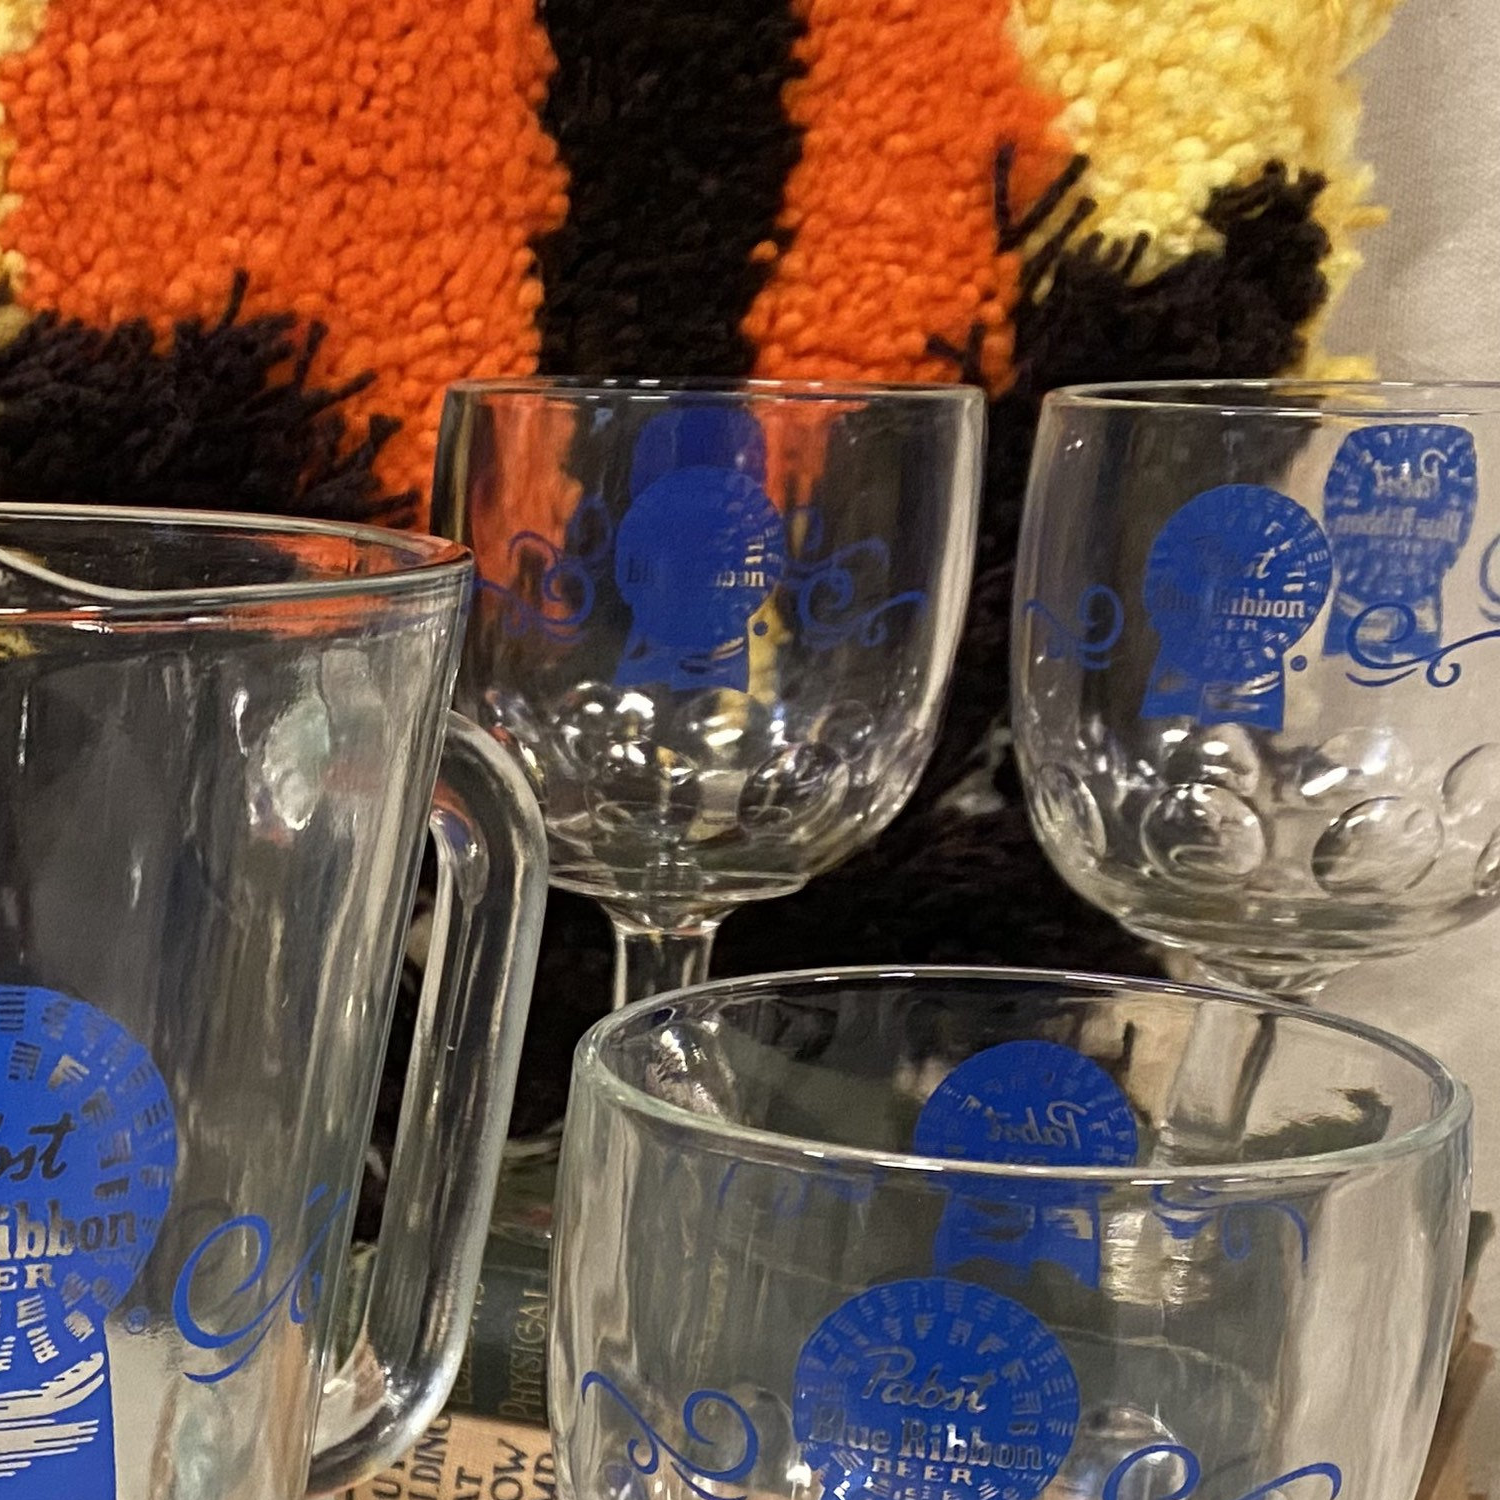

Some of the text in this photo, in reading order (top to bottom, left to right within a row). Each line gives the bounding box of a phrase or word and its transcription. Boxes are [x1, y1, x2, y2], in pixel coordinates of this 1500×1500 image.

[861, 1346, 998, 1412] Pabst
[809, 1400, 1044, 1471] Blue Ribbon
[871, 1456, 973, 1487] BEER
